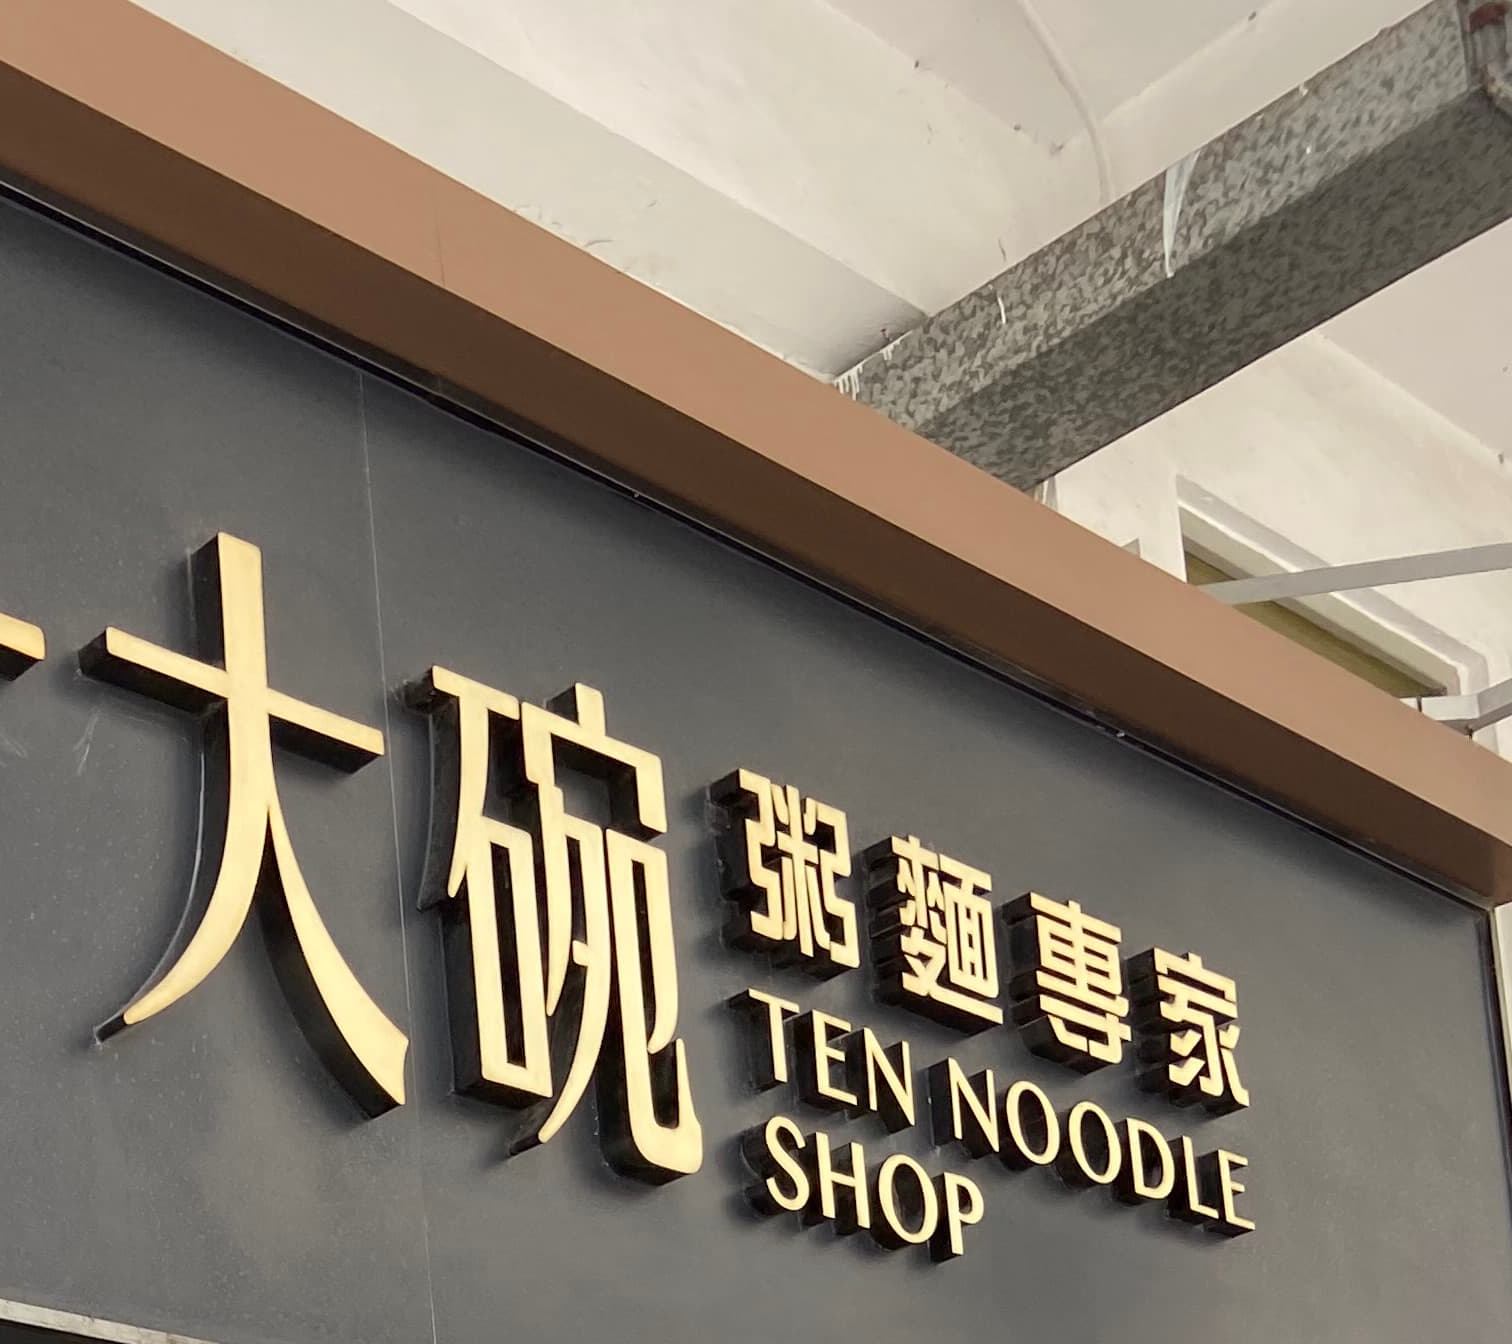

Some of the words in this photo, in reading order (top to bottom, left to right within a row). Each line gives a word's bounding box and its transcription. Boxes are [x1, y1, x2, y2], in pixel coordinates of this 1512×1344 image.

[730, 770, 1250, 1111] 粥麵專家
[748, 990, 915, 1127] TEN
[943, 1060, 1256, 1233] NOODLE
[756, 1116, 986, 1260] SHOP
